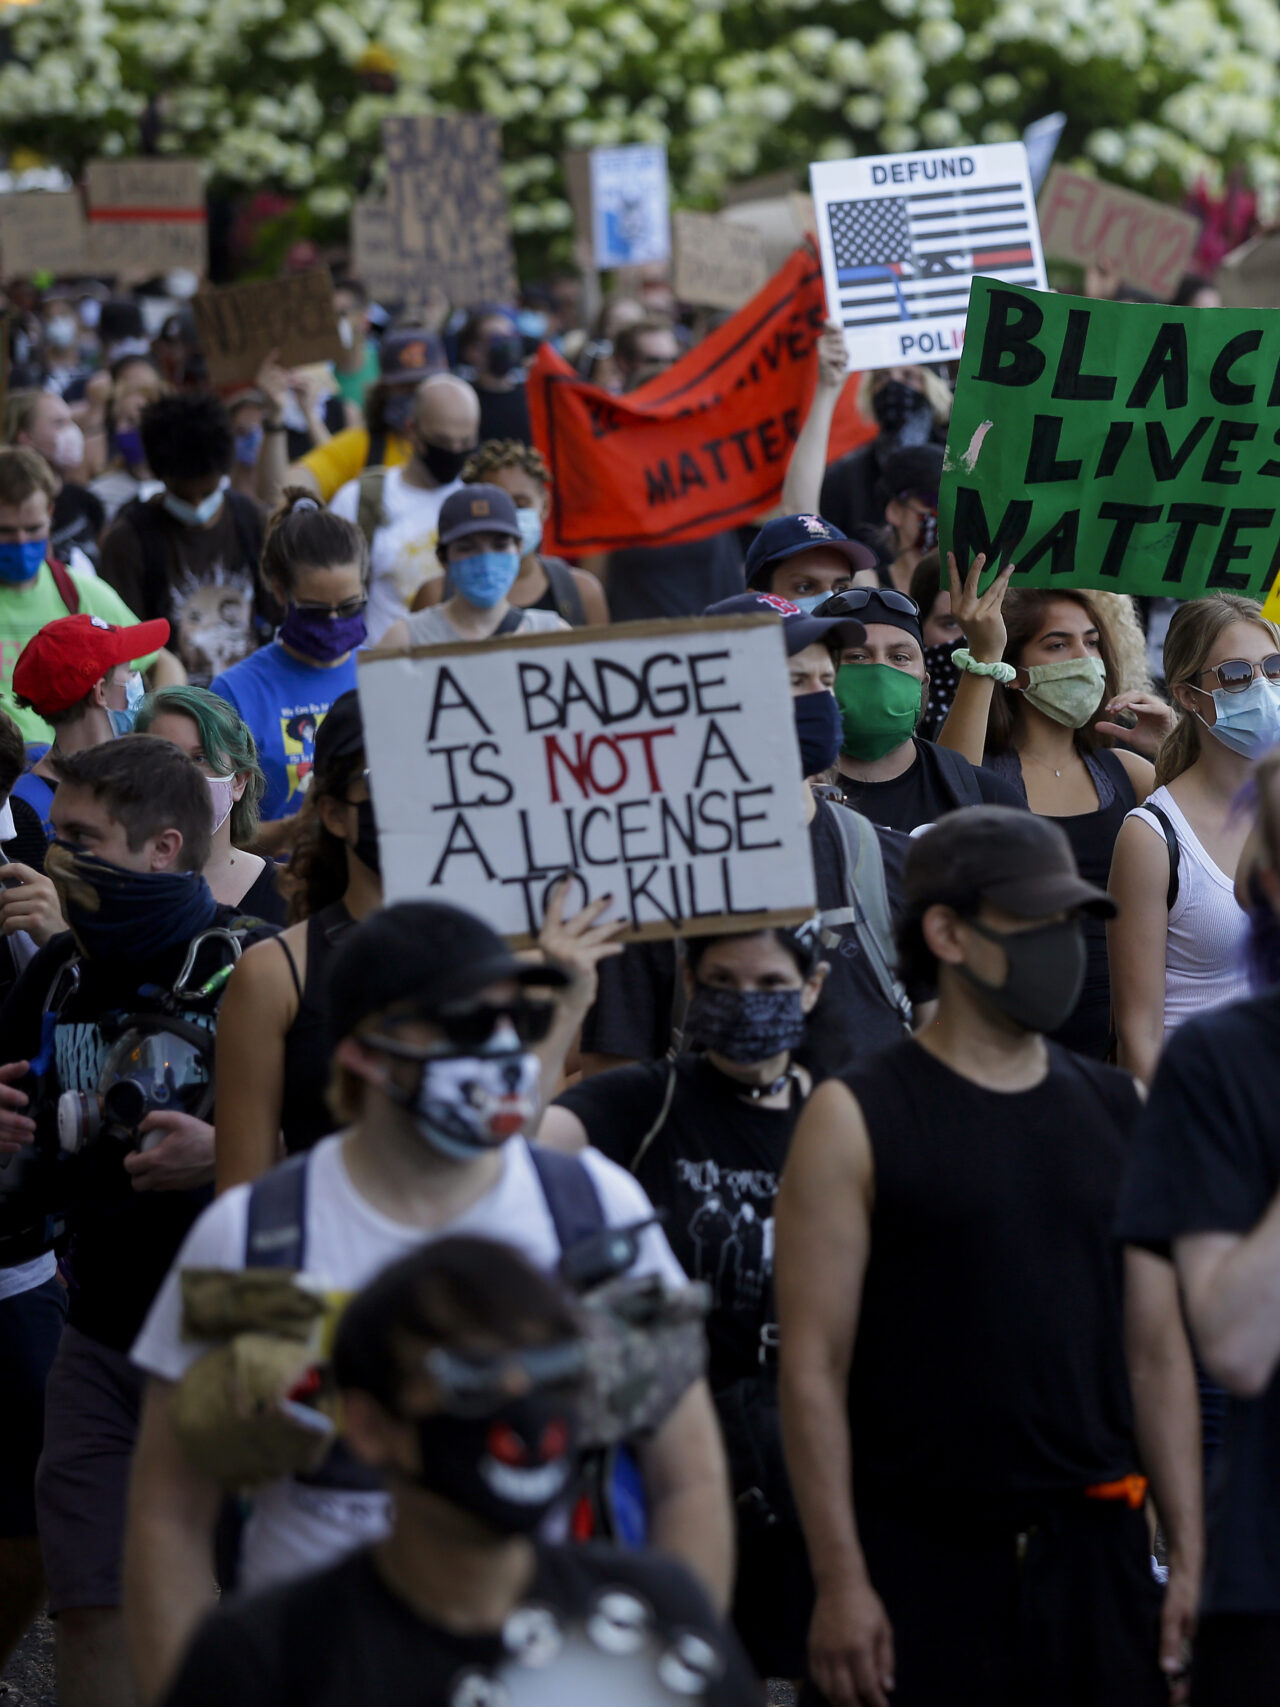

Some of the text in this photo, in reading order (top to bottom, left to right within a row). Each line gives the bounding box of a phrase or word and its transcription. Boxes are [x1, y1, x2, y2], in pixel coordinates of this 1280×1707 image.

[872, 157, 975, 186] DEFUND
[901, 329, 966, 355] POLI
[427, 650, 742, 741] A BADGE
[428, 718, 752, 812] IS NOT A
[429, 785, 782, 886] A LICENSE
[501, 857, 768, 939] TO KILL
